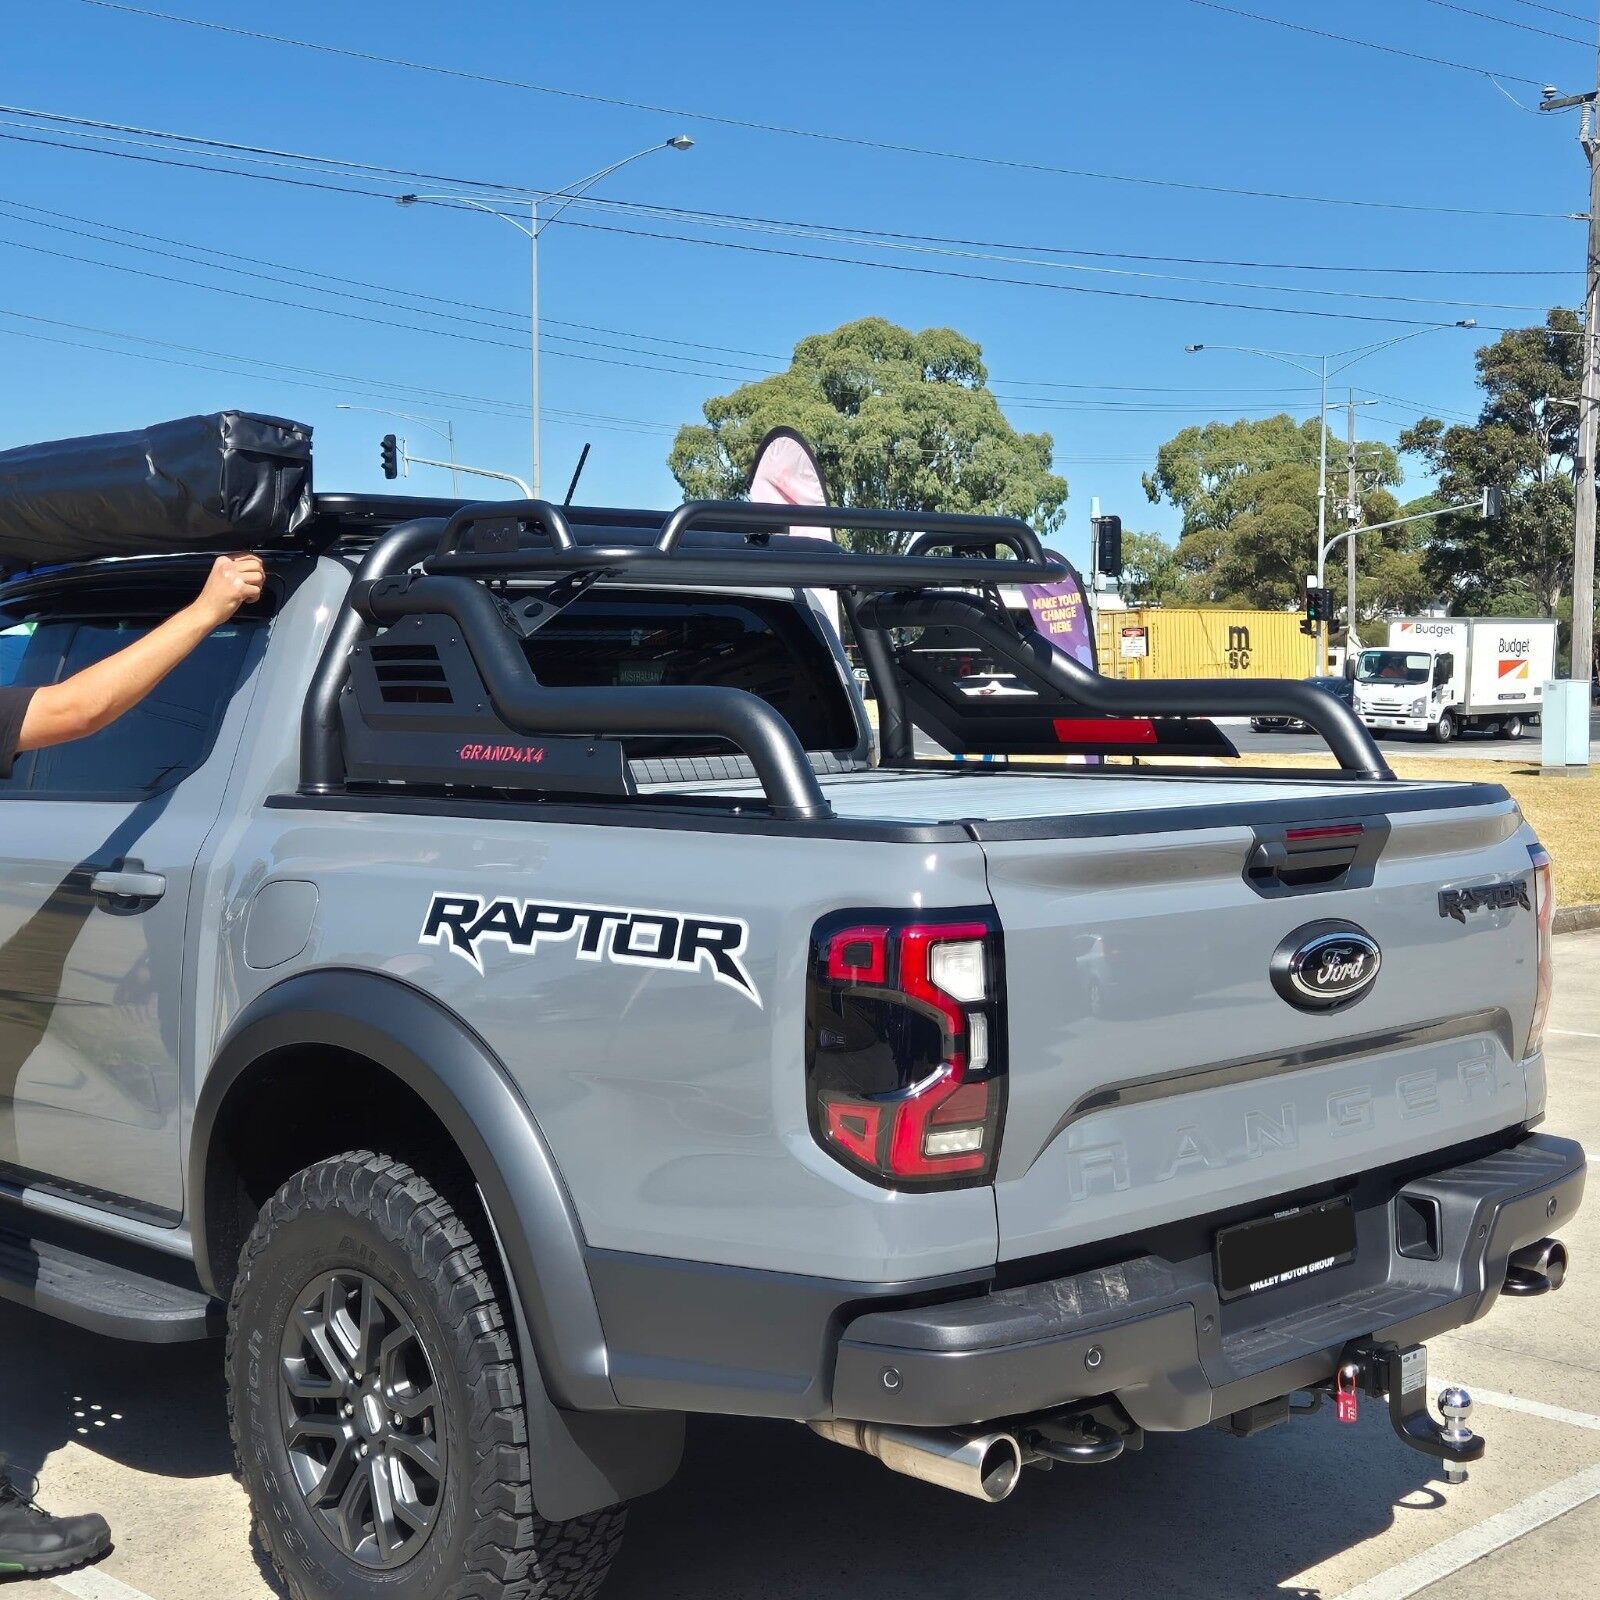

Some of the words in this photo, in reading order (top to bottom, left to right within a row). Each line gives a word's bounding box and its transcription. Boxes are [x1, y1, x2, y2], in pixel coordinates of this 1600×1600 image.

[1033, 595, 1057, 609] MAKE
[1057, 592, 1082, 606] YOUR
[1041, 607, 1077, 622] CHANGE
[1050, 620, 1073, 634] HERE
[1415, 622, 1455, 637] Budget
[1498, 637, 1530, 657] Budget
[460, 743, 545, 764] GRAND4X4
[1438, 879, 1531, 925] RAPTOR
[418, 891, 764, 1011] RAPTOR
[1316, 947, 1364, 985] Ford
[1066, 1054, 1498, 1201] RANGER
[1249, 1275, 1279, 1291] VALLEY
[1280, 1266, 1308, 1282] MOTOR
[1308, 1257, 1335, 1272] GROUP
